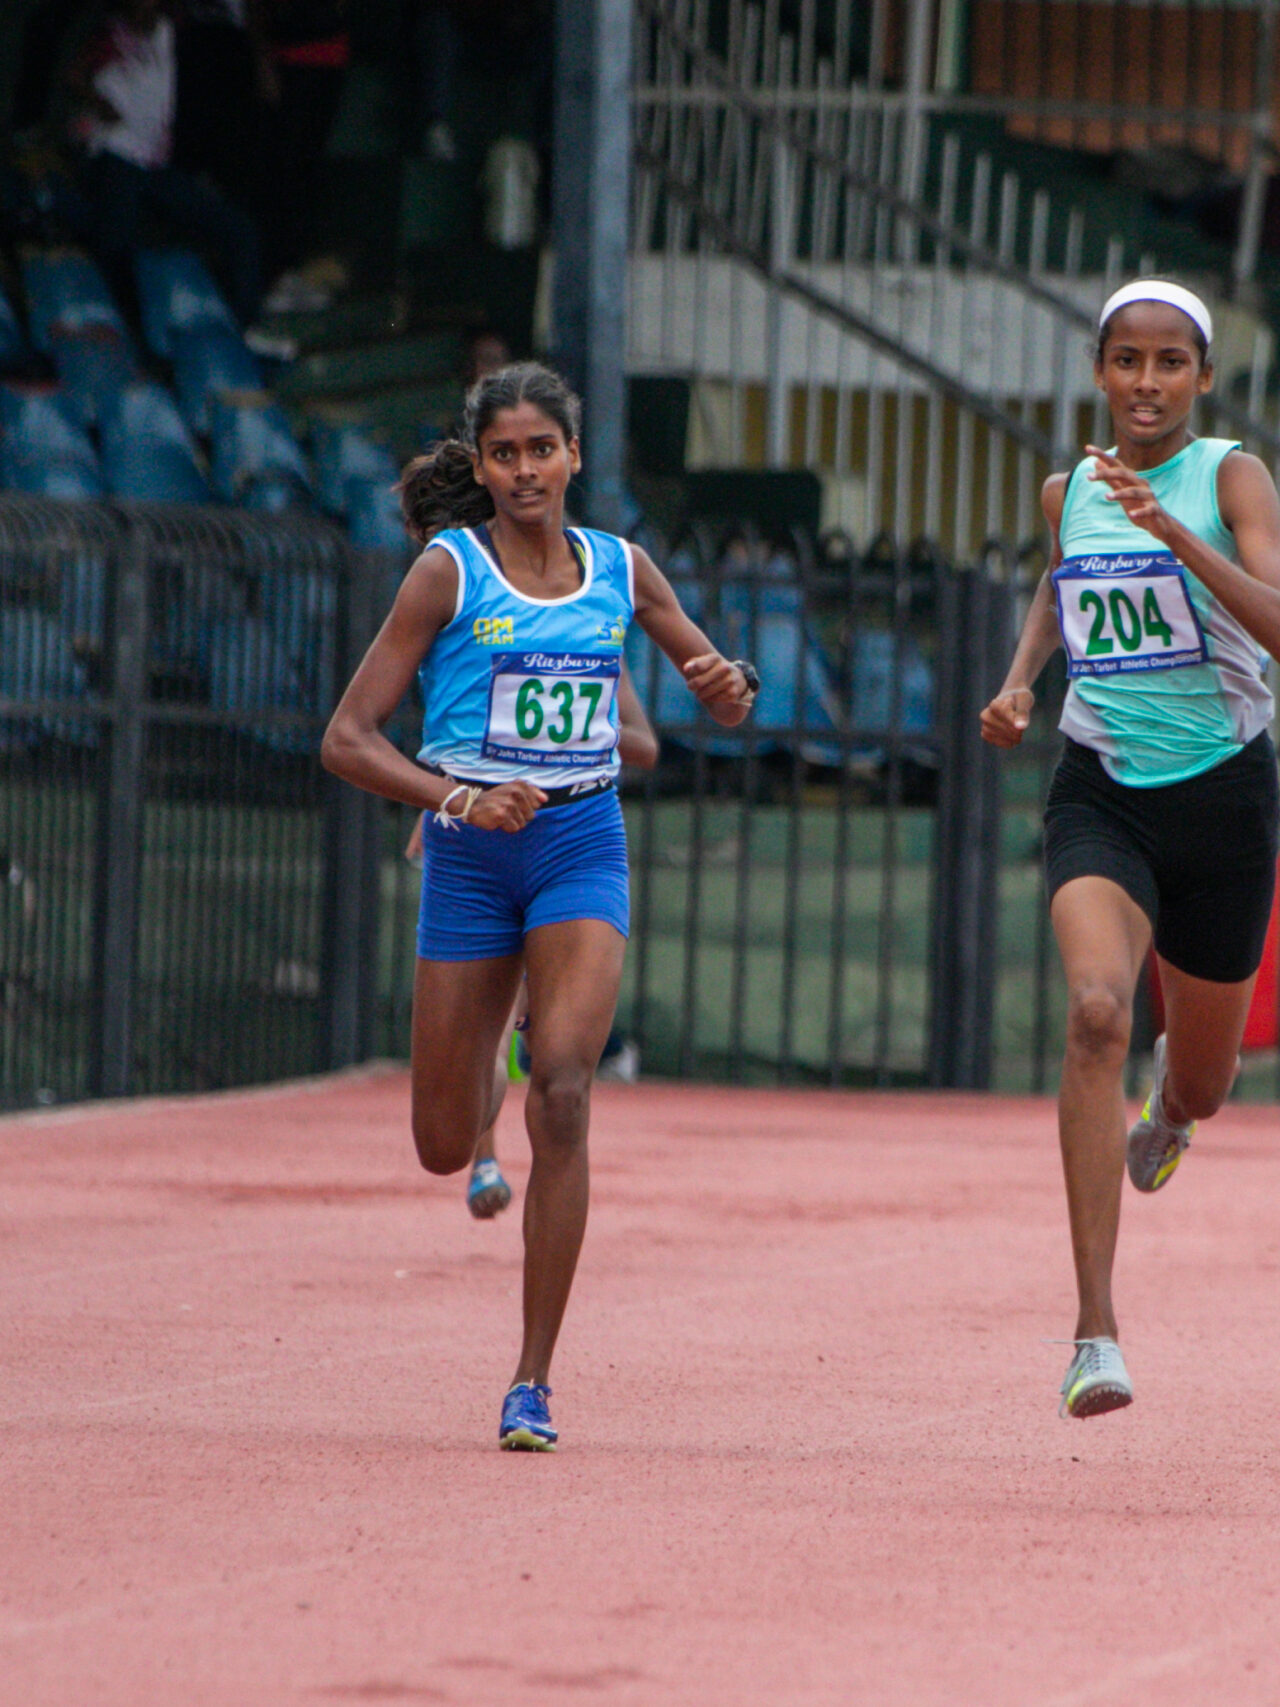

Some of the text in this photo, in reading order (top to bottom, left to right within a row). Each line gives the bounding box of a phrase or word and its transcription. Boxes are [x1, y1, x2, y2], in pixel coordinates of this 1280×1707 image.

[1079, 556, 1153, 574] Ritzbury
[1079, 587, 1174, 655] 204
[476, 634, 514, 645] TEAM
[523, 653, 601, 671] Ritzbury
[1120, 659, 1149, 669] Athletic
[515, 678, 603, 744] 637
[497, 750, 516, 759] John
[518, 751, 542, 762] Tarbet
[544, 754, 571, 763] Athletic
